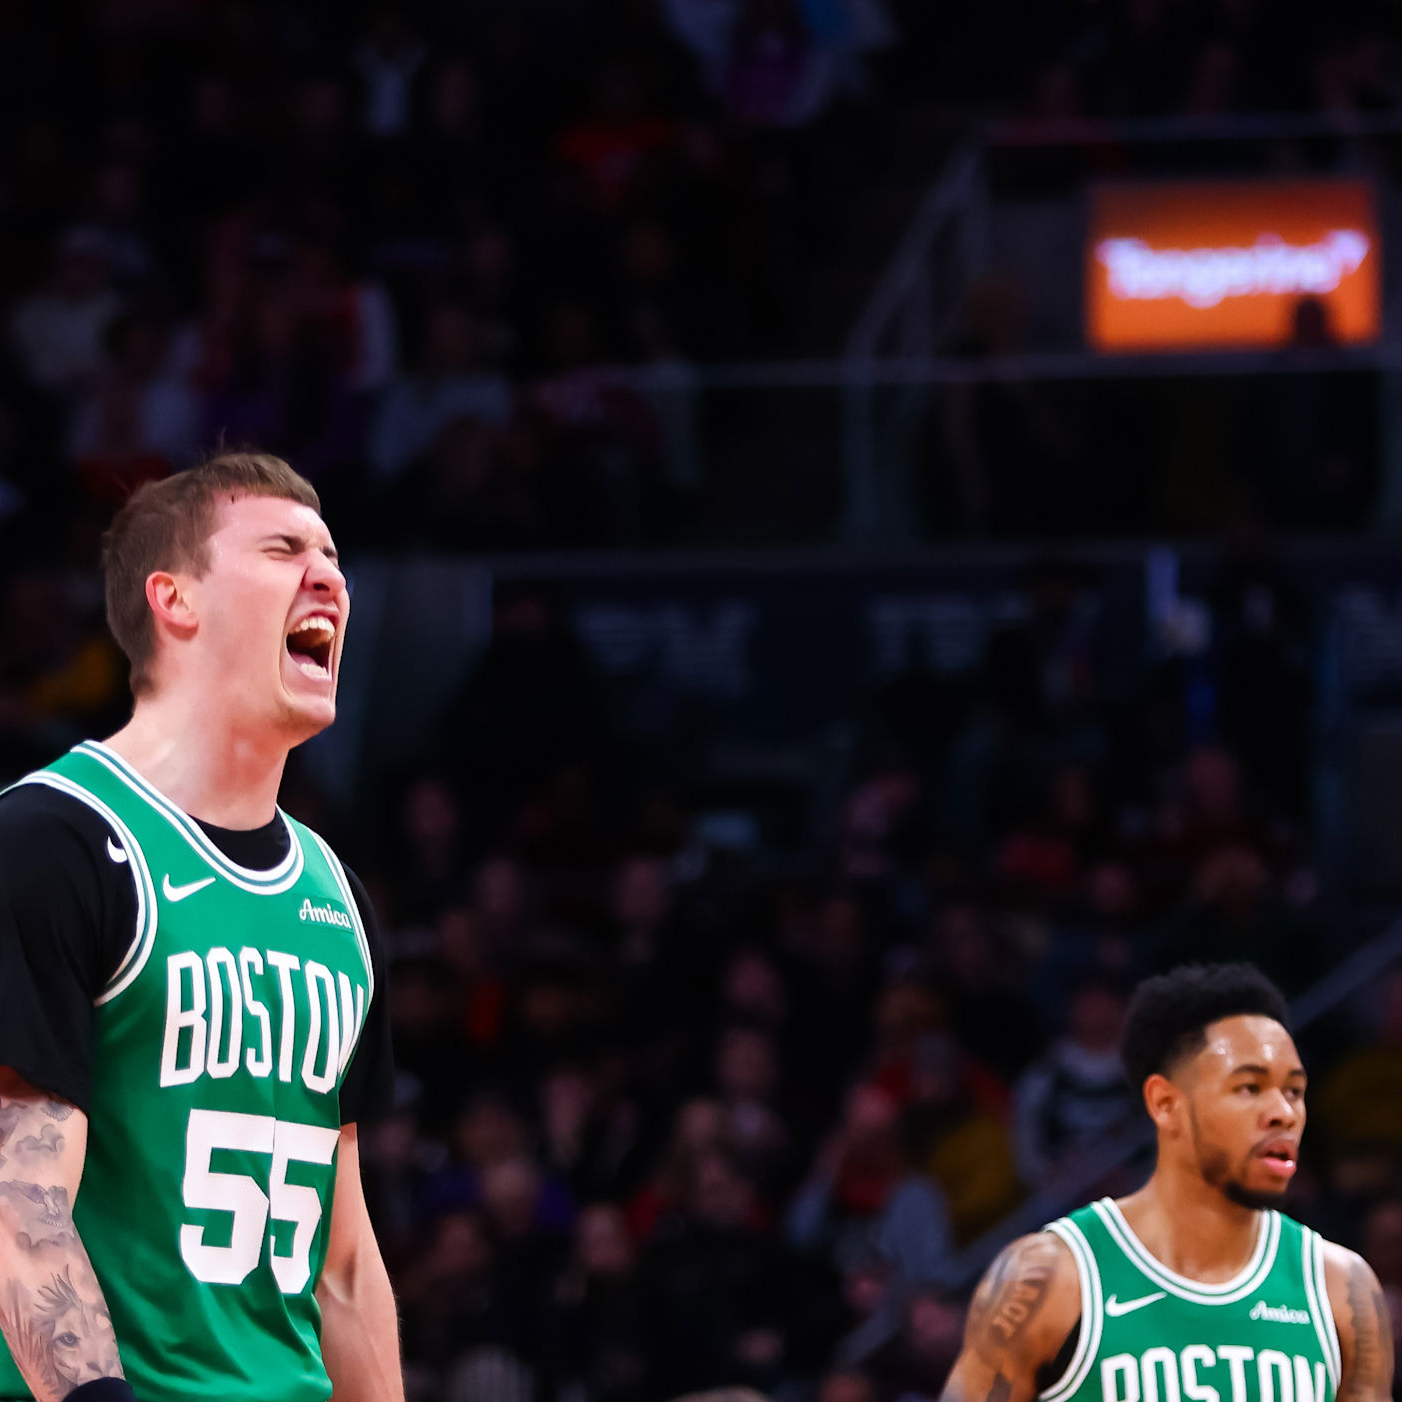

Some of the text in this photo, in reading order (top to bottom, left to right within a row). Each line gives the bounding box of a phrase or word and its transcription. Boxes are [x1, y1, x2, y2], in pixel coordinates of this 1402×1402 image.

[299, 898, 352, 929] Amica
[159, 944, 365, 1095] BOSTON
[180, 1107, 340, 1295] 55
